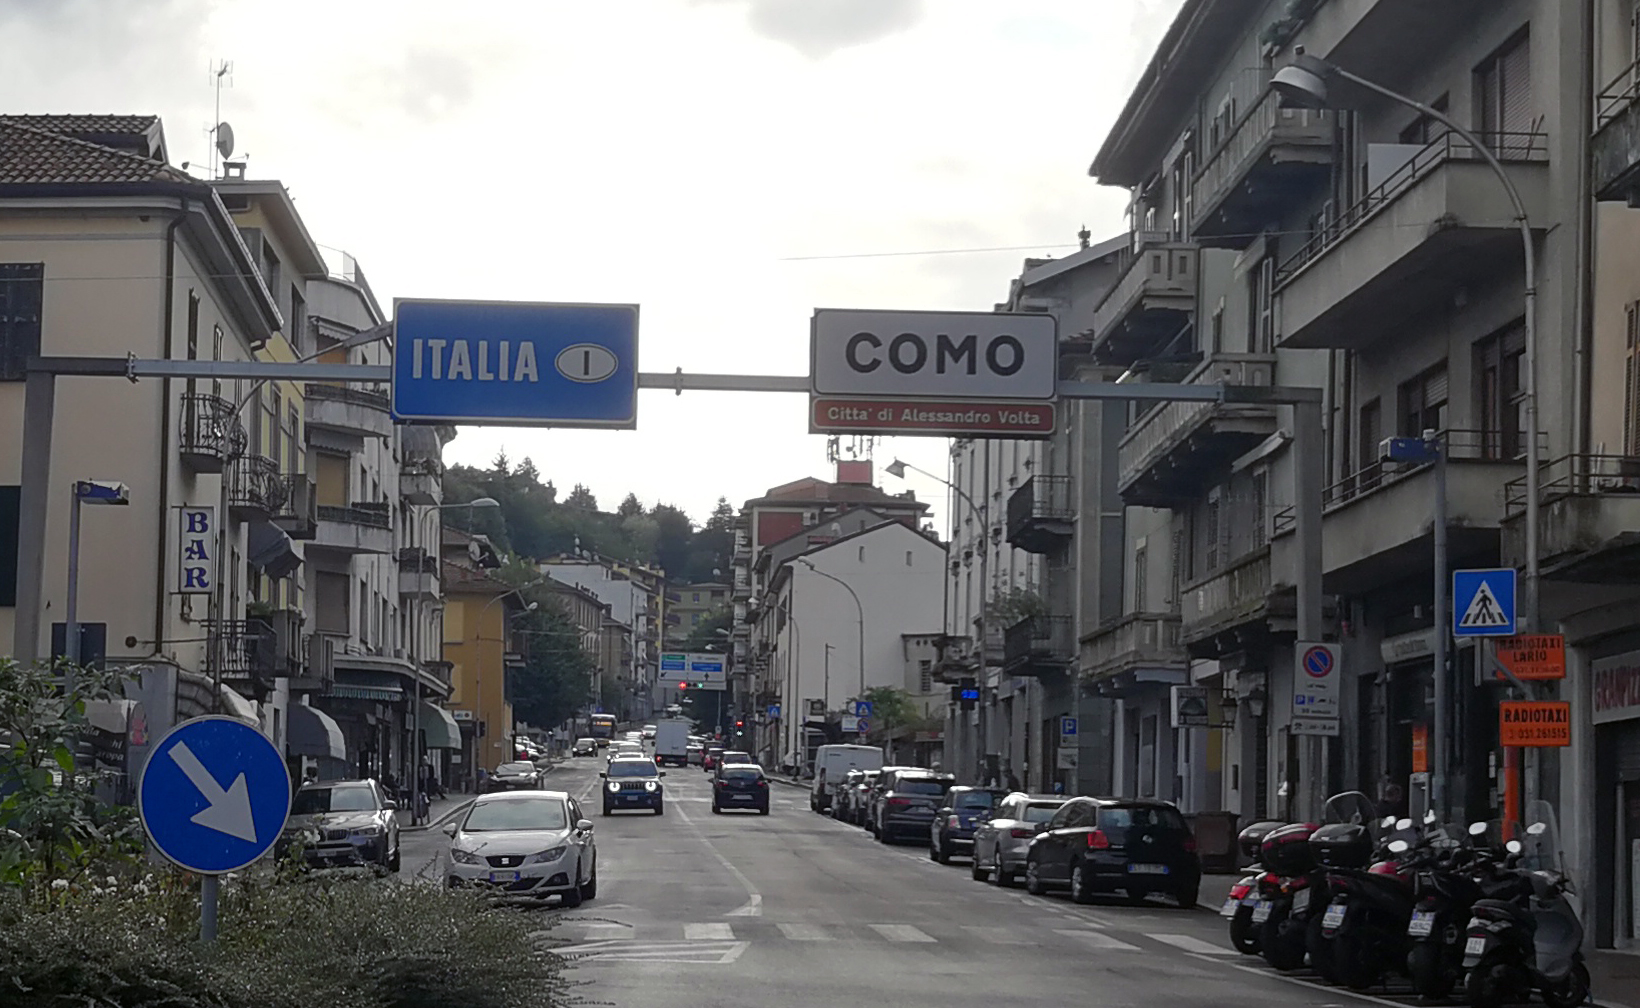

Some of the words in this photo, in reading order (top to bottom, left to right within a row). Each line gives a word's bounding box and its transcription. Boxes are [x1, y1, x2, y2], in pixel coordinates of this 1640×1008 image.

[412, 338, 539, 382] ITALIA
[583, 350, 590, 376] I
[845, 332, 1025, 377] COMO
[877, 408, 893, 421] di
[901, 408, 991, 424] Alessandro
[998, 410, 1041, 425] Volta
[184, 511, 210, 588] BAR
[1499, 637, 1561, 651] RADIOTAXI
[1513, 650, 1547, 662] LARIO
[1504, 707, 1567, 723] RADIOTAXI
